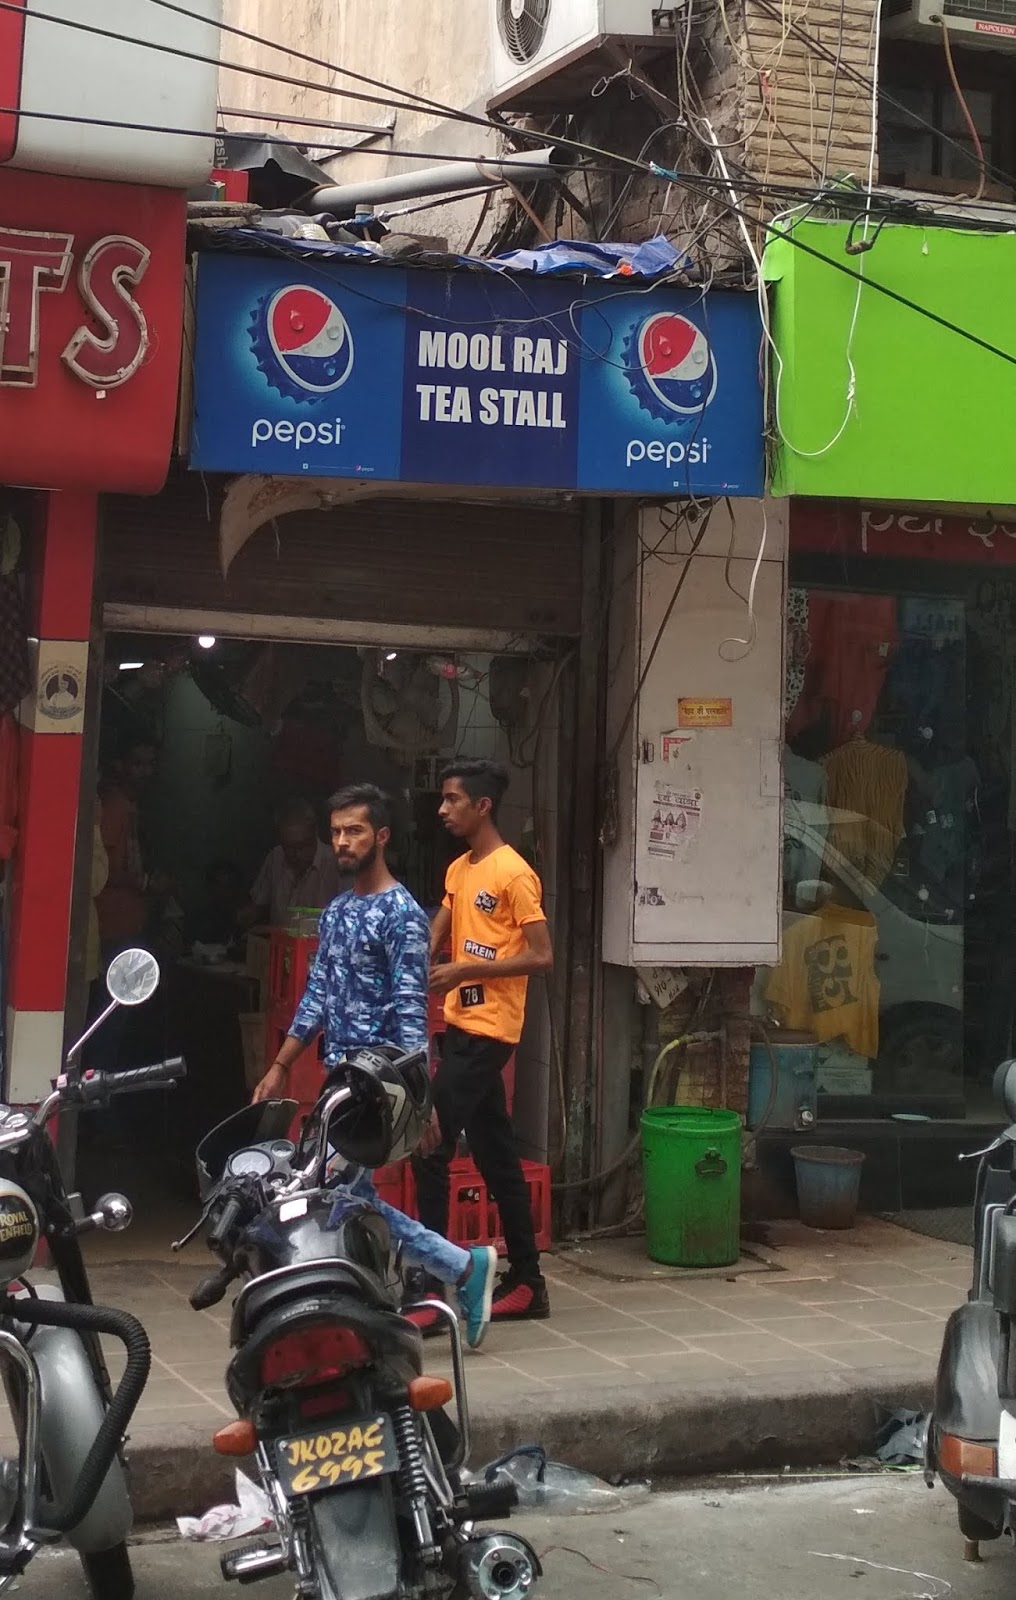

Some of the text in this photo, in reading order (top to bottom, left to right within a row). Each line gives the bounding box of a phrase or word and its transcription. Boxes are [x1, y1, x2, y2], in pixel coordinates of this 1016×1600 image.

[978, 23, 1015, 35] NAPOLEON
[418, 331, 568, 375] MOOL RAJ
[416, 385, 566, 428] TEA STALL
[251, 418, 342, 449] pepsi
[626, 437, 708, 468] pepsi
[465, 989, 479, 1004] 78
[292, 1450, 386, 1492] 6995
